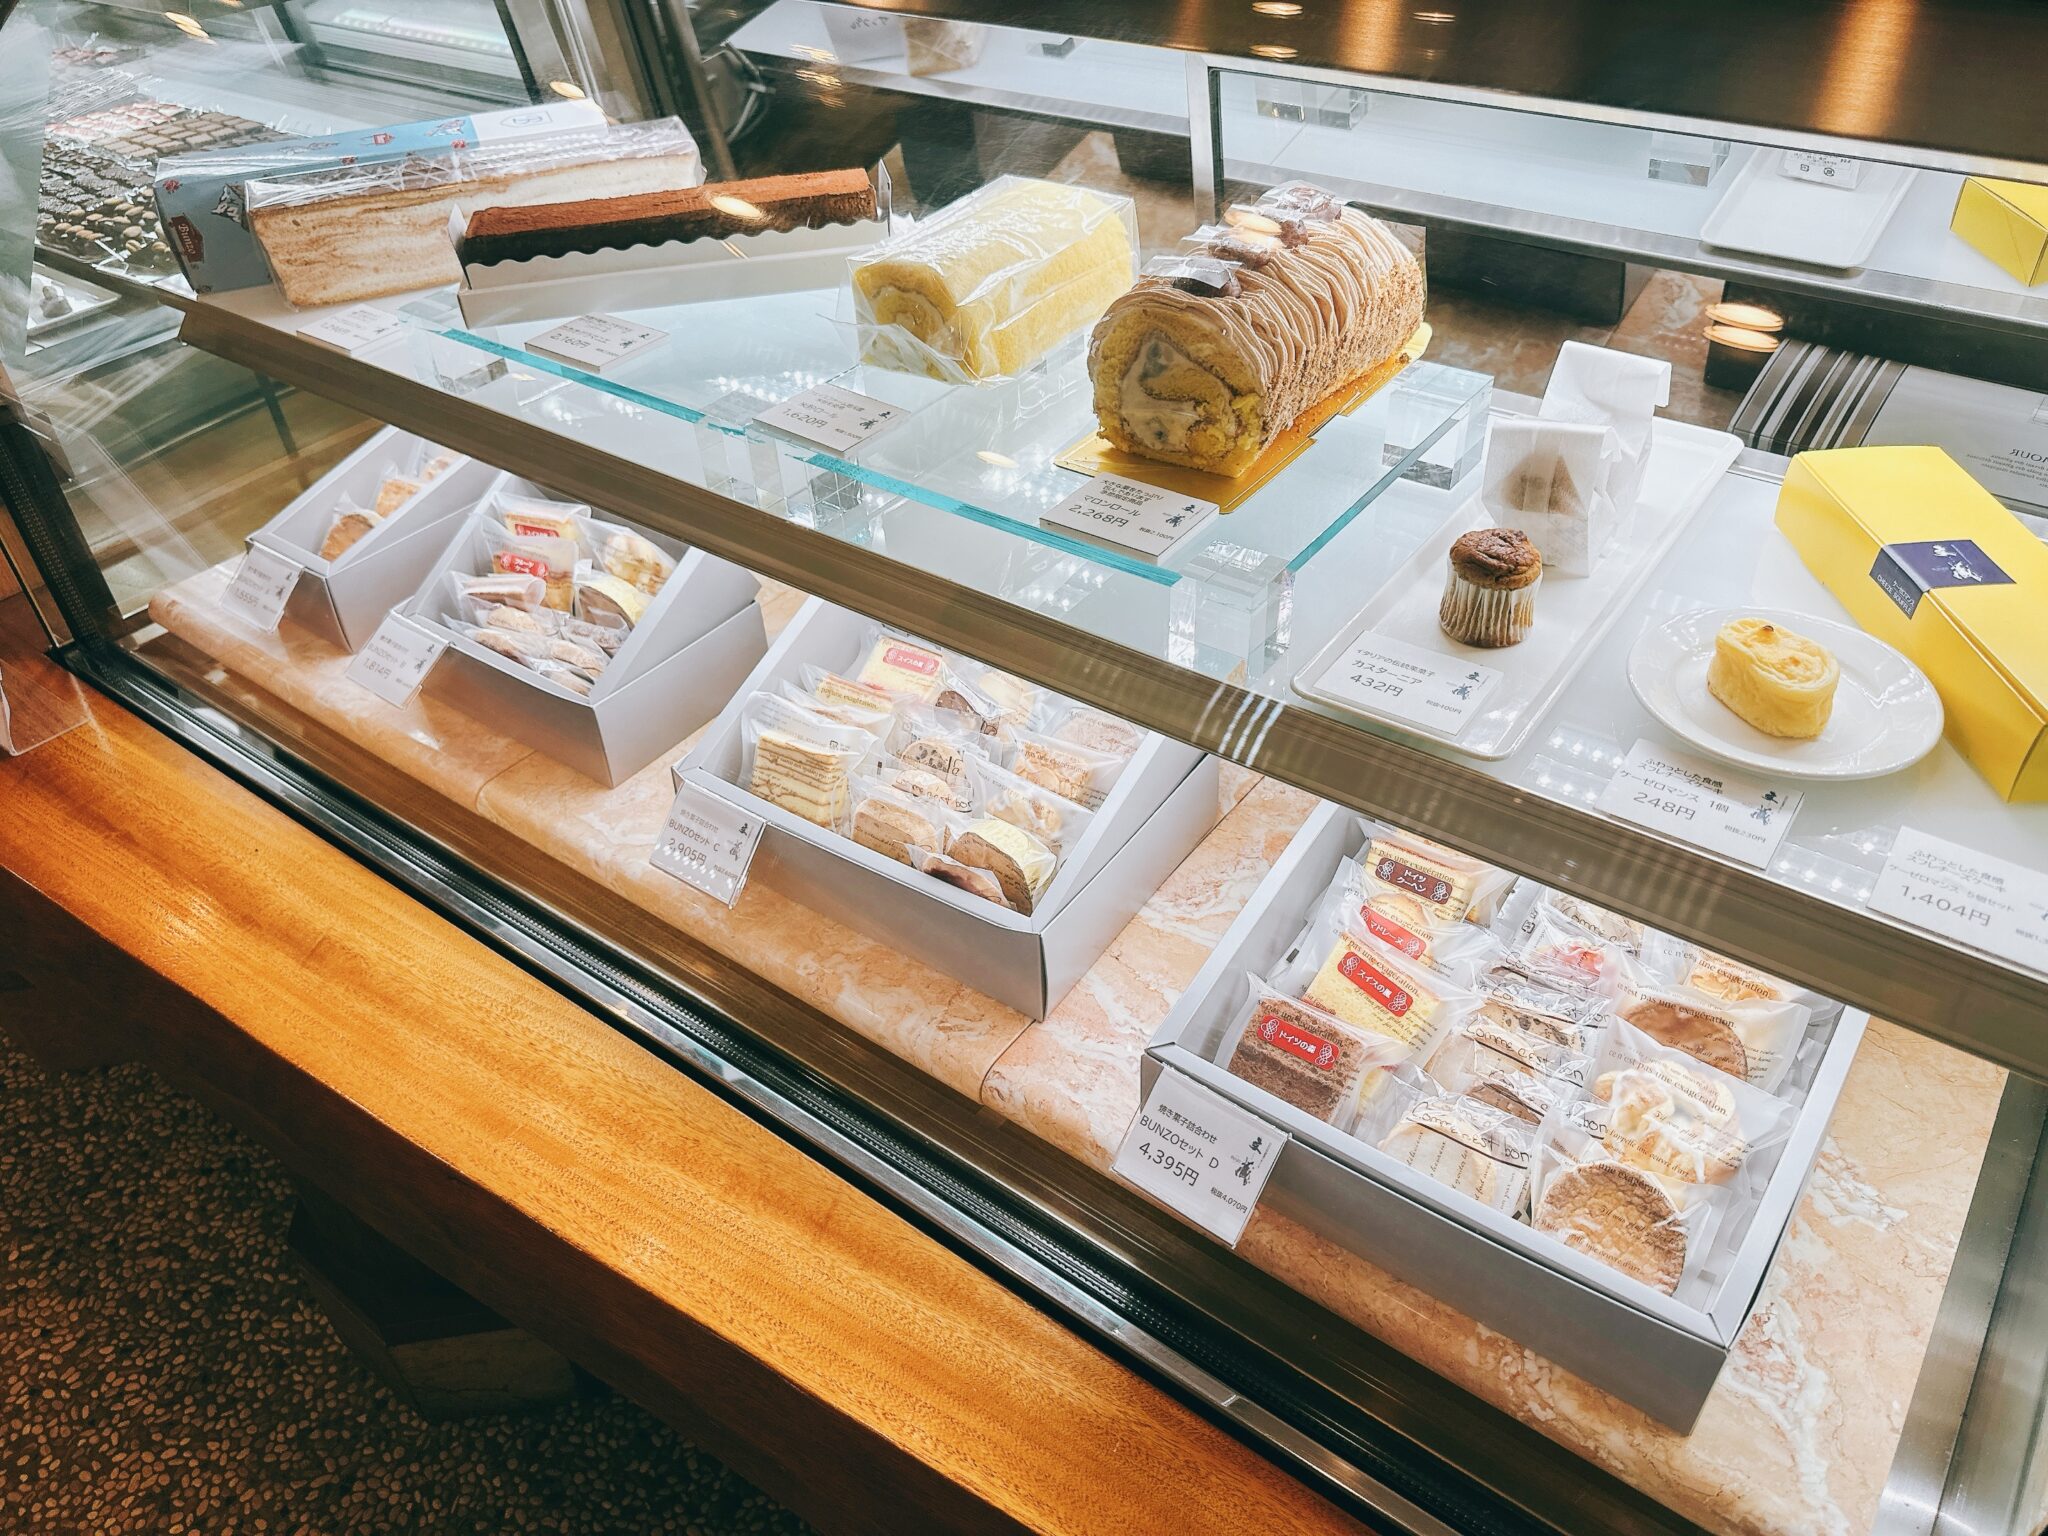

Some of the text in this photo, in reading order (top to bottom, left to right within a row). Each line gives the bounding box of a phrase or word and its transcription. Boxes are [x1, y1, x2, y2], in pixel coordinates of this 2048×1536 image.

[1068, 504, 1129, 528] 2,268円
[1084, 495, 1141, 517] マロンロール
[1350, 674, 1404, 697] 432円
[1351, 659, 1423, 685] カスターニア
[1645, 759, 1724, 788] ふわっとした食感
[1619, 770, 1729, 813] ケーゼロマンス 1個
[1633, 792, 1696, 821] 248円
[668, 819, 721, 852] BUNZOセット C
[668, 838, 707, 867] 2,905円
[1396, 877, 1427, 892] クーヘン
[1403, 869, 1427, 882] ドイツ
[1900, 885, 1991, 927] 1,404円
[1370, 919, 1404, 946] マドレーヌ
[1640, 992, 1657, 1004] pas
[1658, 998, 1677, 1010] une
[1636, 1061, 1653, 1075] pas
[1655, 1070, 1673, 1084] une
[1158, 1104, 1218, 1145] 焼き菓子詰合わせ
[1583, 1113, 1608, 1133] bon
[1140, 1114, 1219, 1169] BUNZOセット D
[1139, 1142, 1200, 1187] 4,395円
[1210, 1186, 1248, 1214] 税抜4,070円
